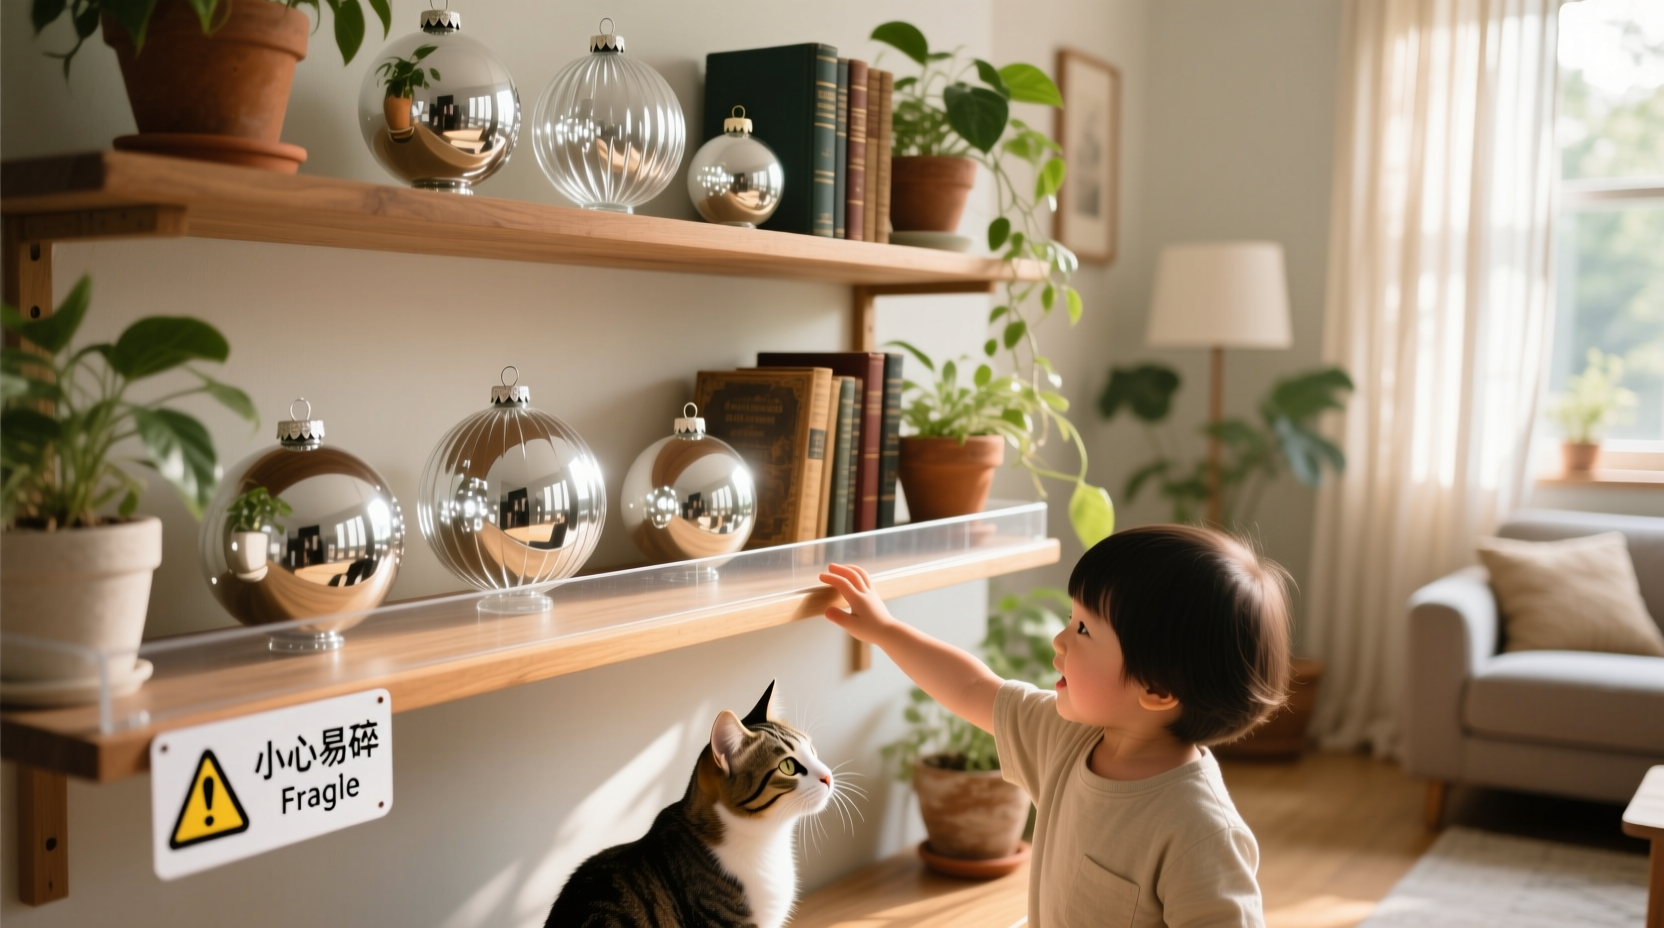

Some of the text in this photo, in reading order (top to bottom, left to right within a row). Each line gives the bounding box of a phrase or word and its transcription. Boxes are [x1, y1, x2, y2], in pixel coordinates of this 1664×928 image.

[255, 719, 379, 780] 小心易碎
[282, 773, 360, 815] Fragle
